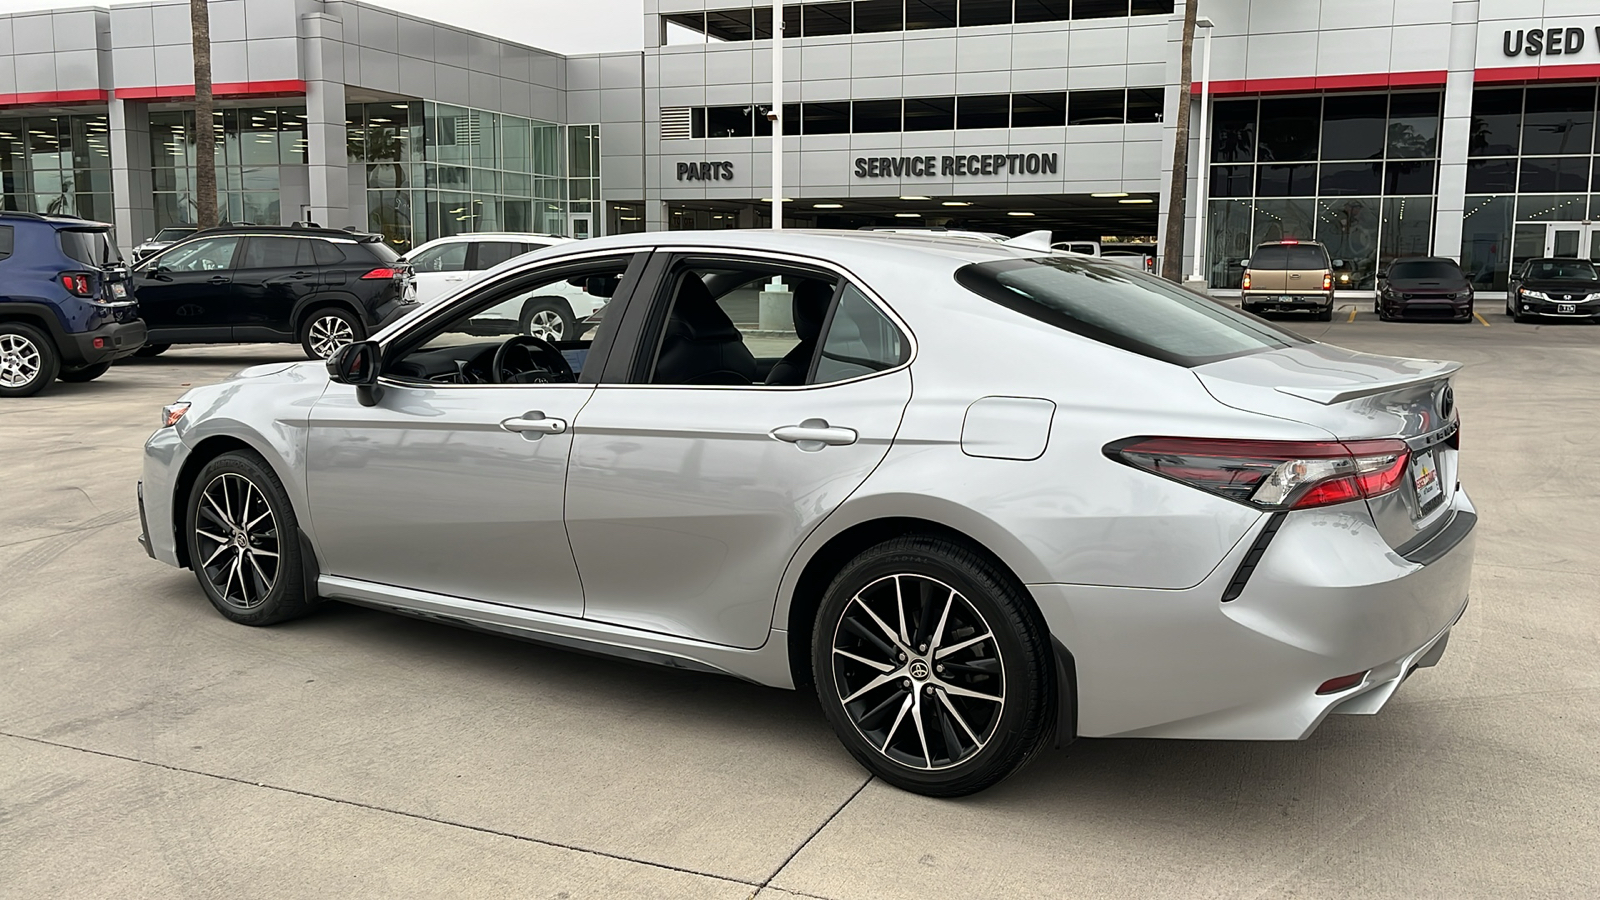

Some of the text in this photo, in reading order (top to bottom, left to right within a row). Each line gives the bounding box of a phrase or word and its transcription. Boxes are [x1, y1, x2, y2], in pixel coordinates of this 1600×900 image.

[1503, 27, 1585, 57] USED
[677, 161, 733, 181] PARTS
[854, 153, 1058, 178] SERVICE RECEPTION
